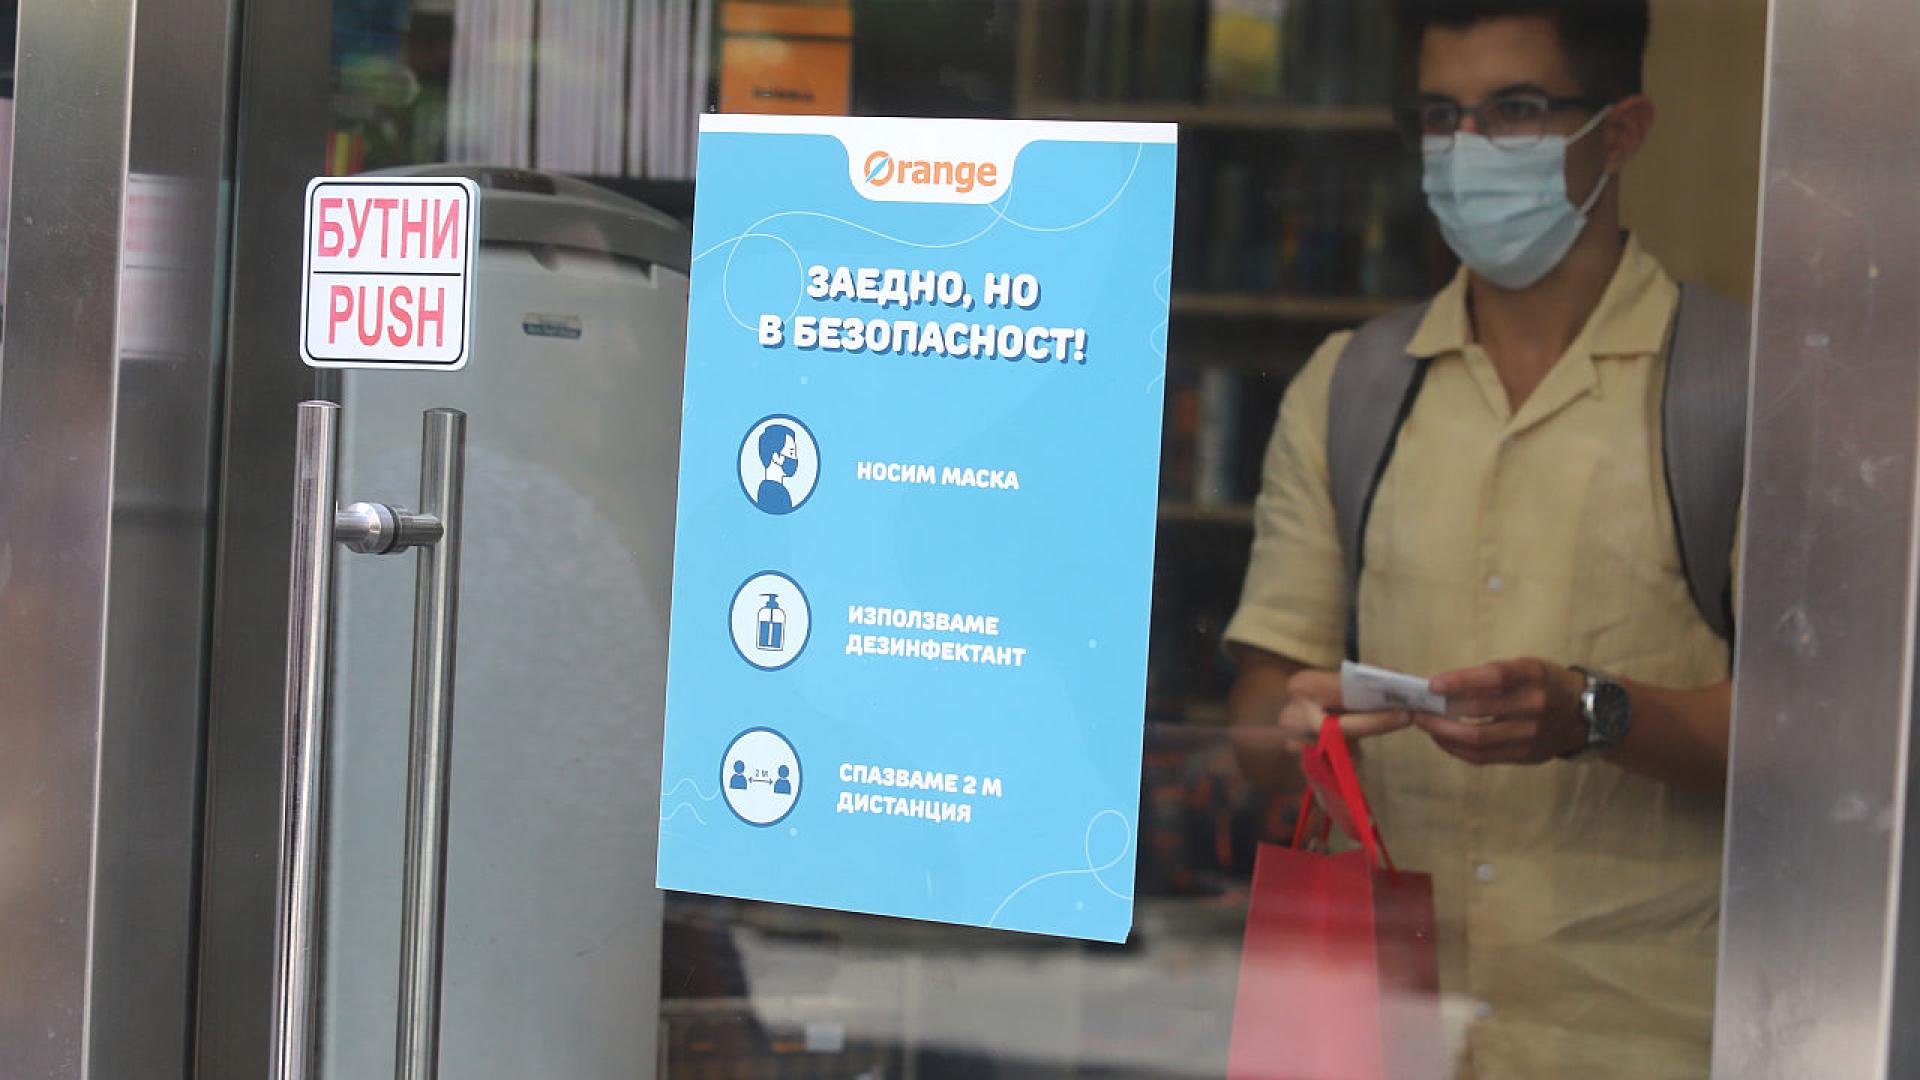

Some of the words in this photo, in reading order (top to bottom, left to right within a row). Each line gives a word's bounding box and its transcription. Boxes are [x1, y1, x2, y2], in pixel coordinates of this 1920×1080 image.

[864, 150, 997, 193] Orange
[317, 197, 460, 259] БУТНИ
[806, 264, 974, 310] ЗАЕДНО,
[984, 272, 1041, 309] НО
[328, 284, 445, 347] PUSH
[758, 314, 785, 348] В
[793, 315, 1088, 364] БЕЗОПАСНОСТ!
[857, 461, 936, 485] НОСИМ
[941, 467, 1019, 490] МАСКА
[848, 605, 1000, 636] ИЗПОЛЗВАМЕ
[845, 633, 1027, 667] ДЕЗИНФЕКТАНТ
[839, 762, 960, 793] СПАЗВАМЕ
[962, 775, 977, 795] 2
[981, 777, 1003, 798] М
[836, 791, 972, 824] ДИСТАНЦИЯ
